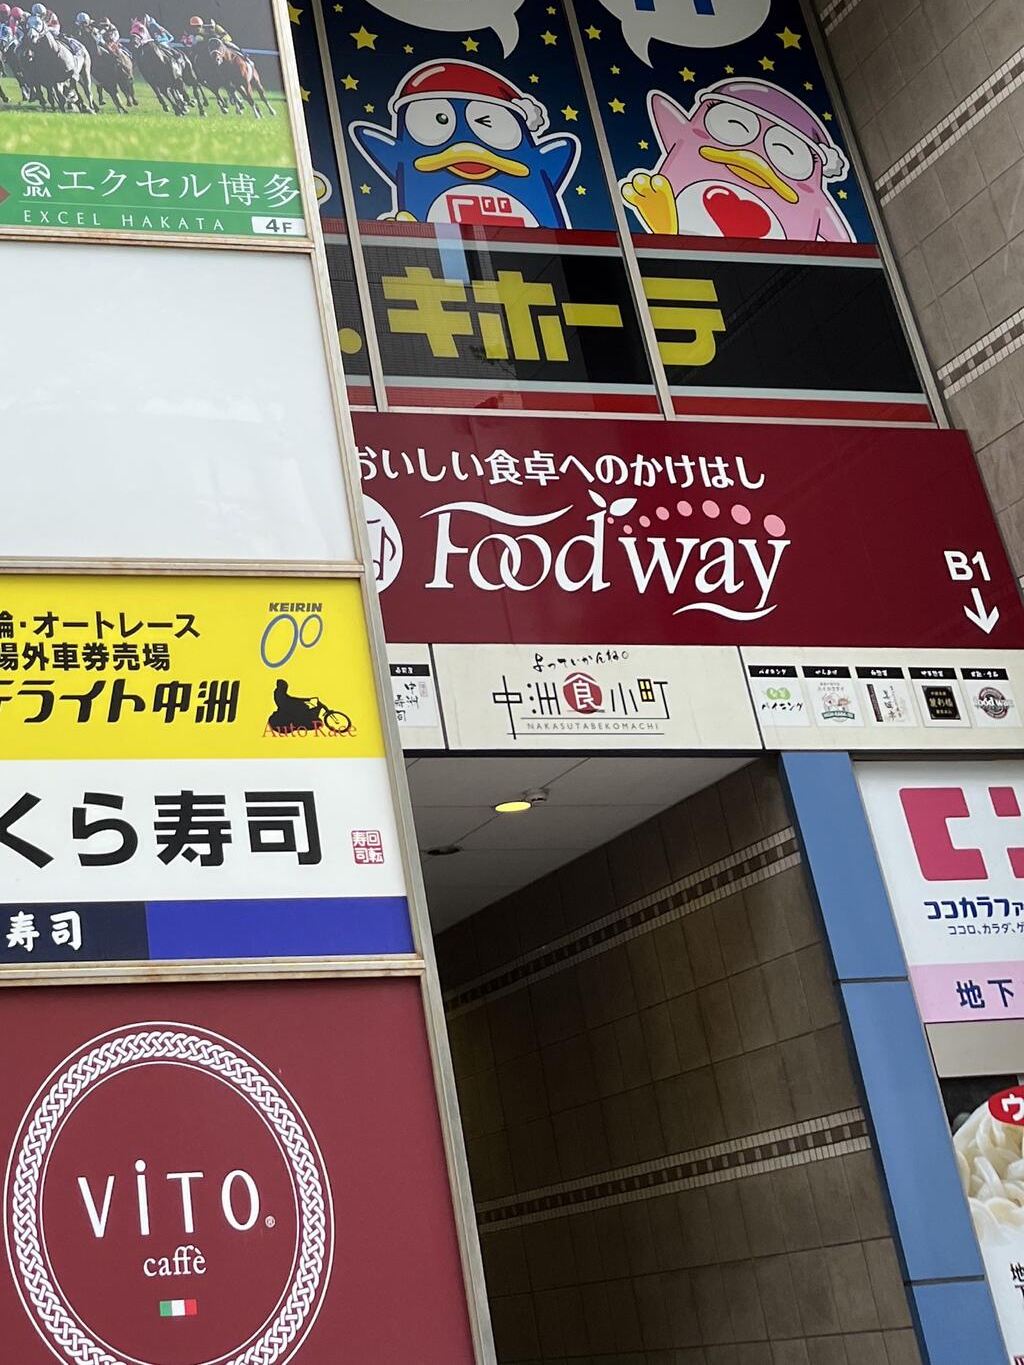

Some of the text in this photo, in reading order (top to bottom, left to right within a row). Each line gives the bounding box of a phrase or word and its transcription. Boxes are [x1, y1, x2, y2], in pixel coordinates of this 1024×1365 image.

[23, 185, 52, 197] JRA
[57, 168, 300, 208] エクセル博多
[23, 209, 225, 231] EXCEL HAKATA
[265, 218, 293, 233] 4F
[943, 549, 992, 582] B1
[268, 601, 323, 613] KEIRIN
[262, 720, 357, 739] Auto Race
[527, 722, 659, 732] NAKASUTABEKOMACHI
[956, 979, 1015, 1009] 地下
